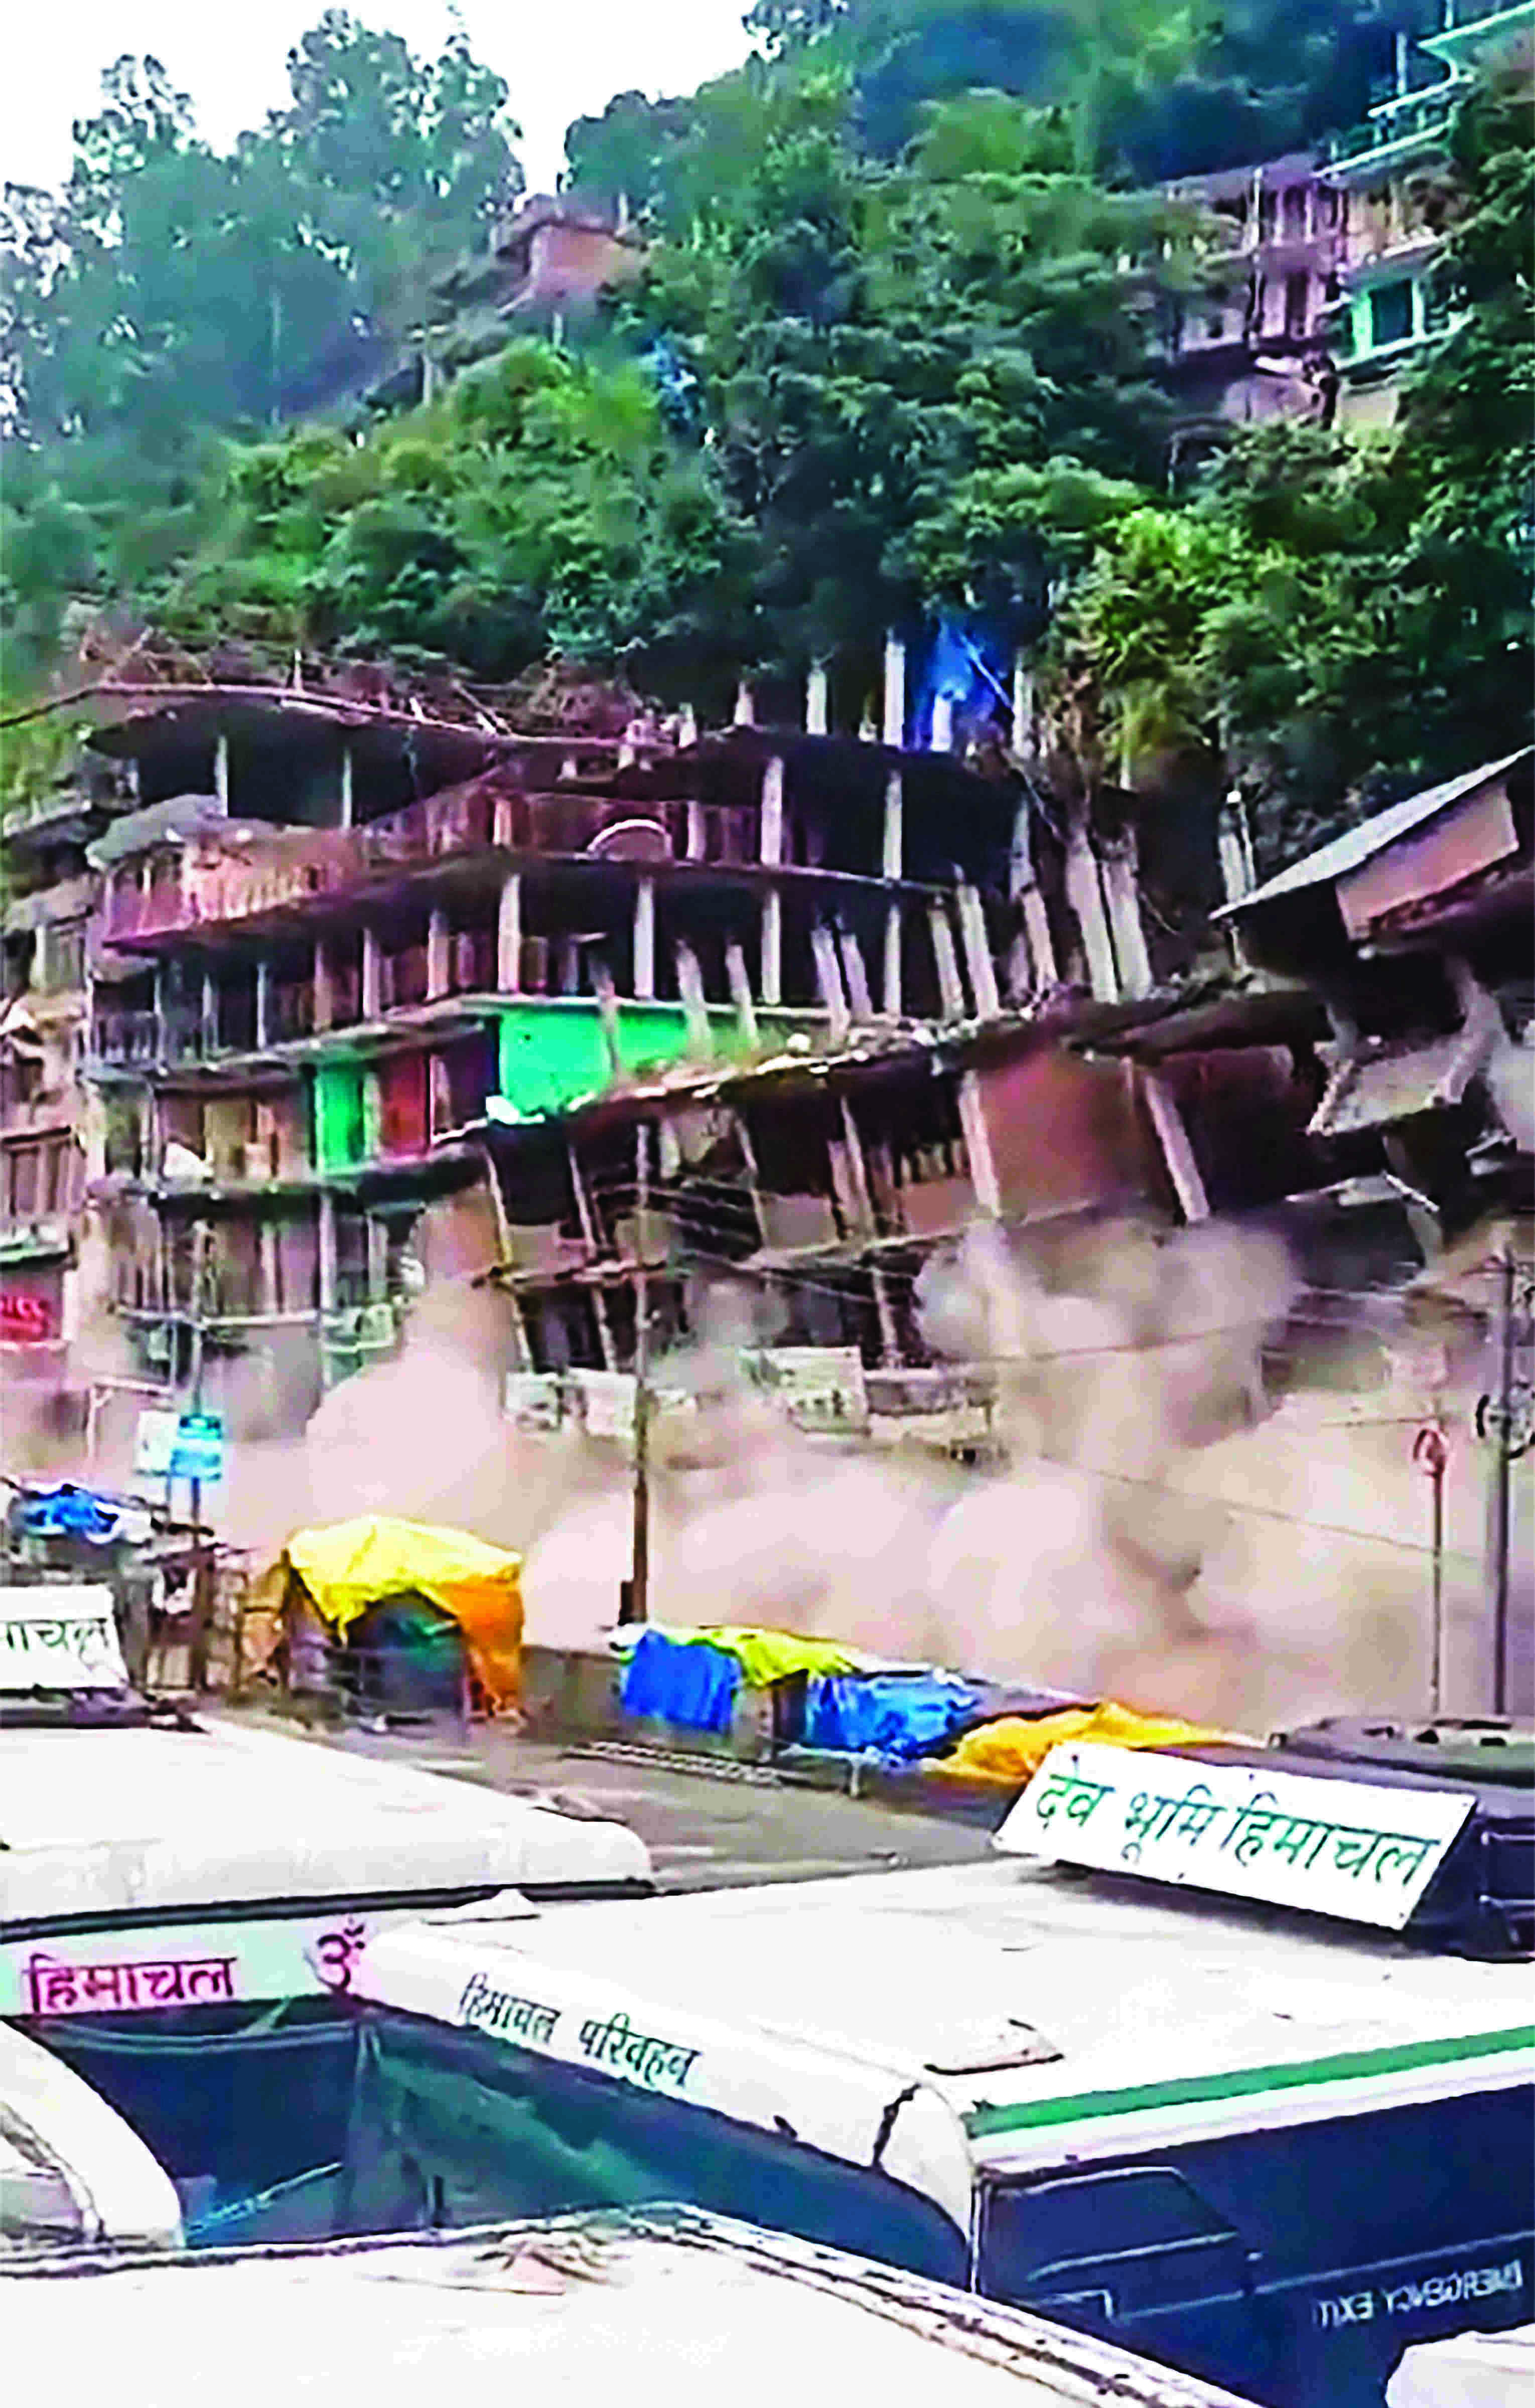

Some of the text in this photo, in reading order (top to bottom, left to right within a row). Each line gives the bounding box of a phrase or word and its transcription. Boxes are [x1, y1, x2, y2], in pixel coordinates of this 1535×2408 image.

[1036, 1756, 1441, 1885] देव भूमि हिमाचल
[22, 1953, 237, 2012] हिमाचल
[579, 2013, 704, 2087] परिवहन
